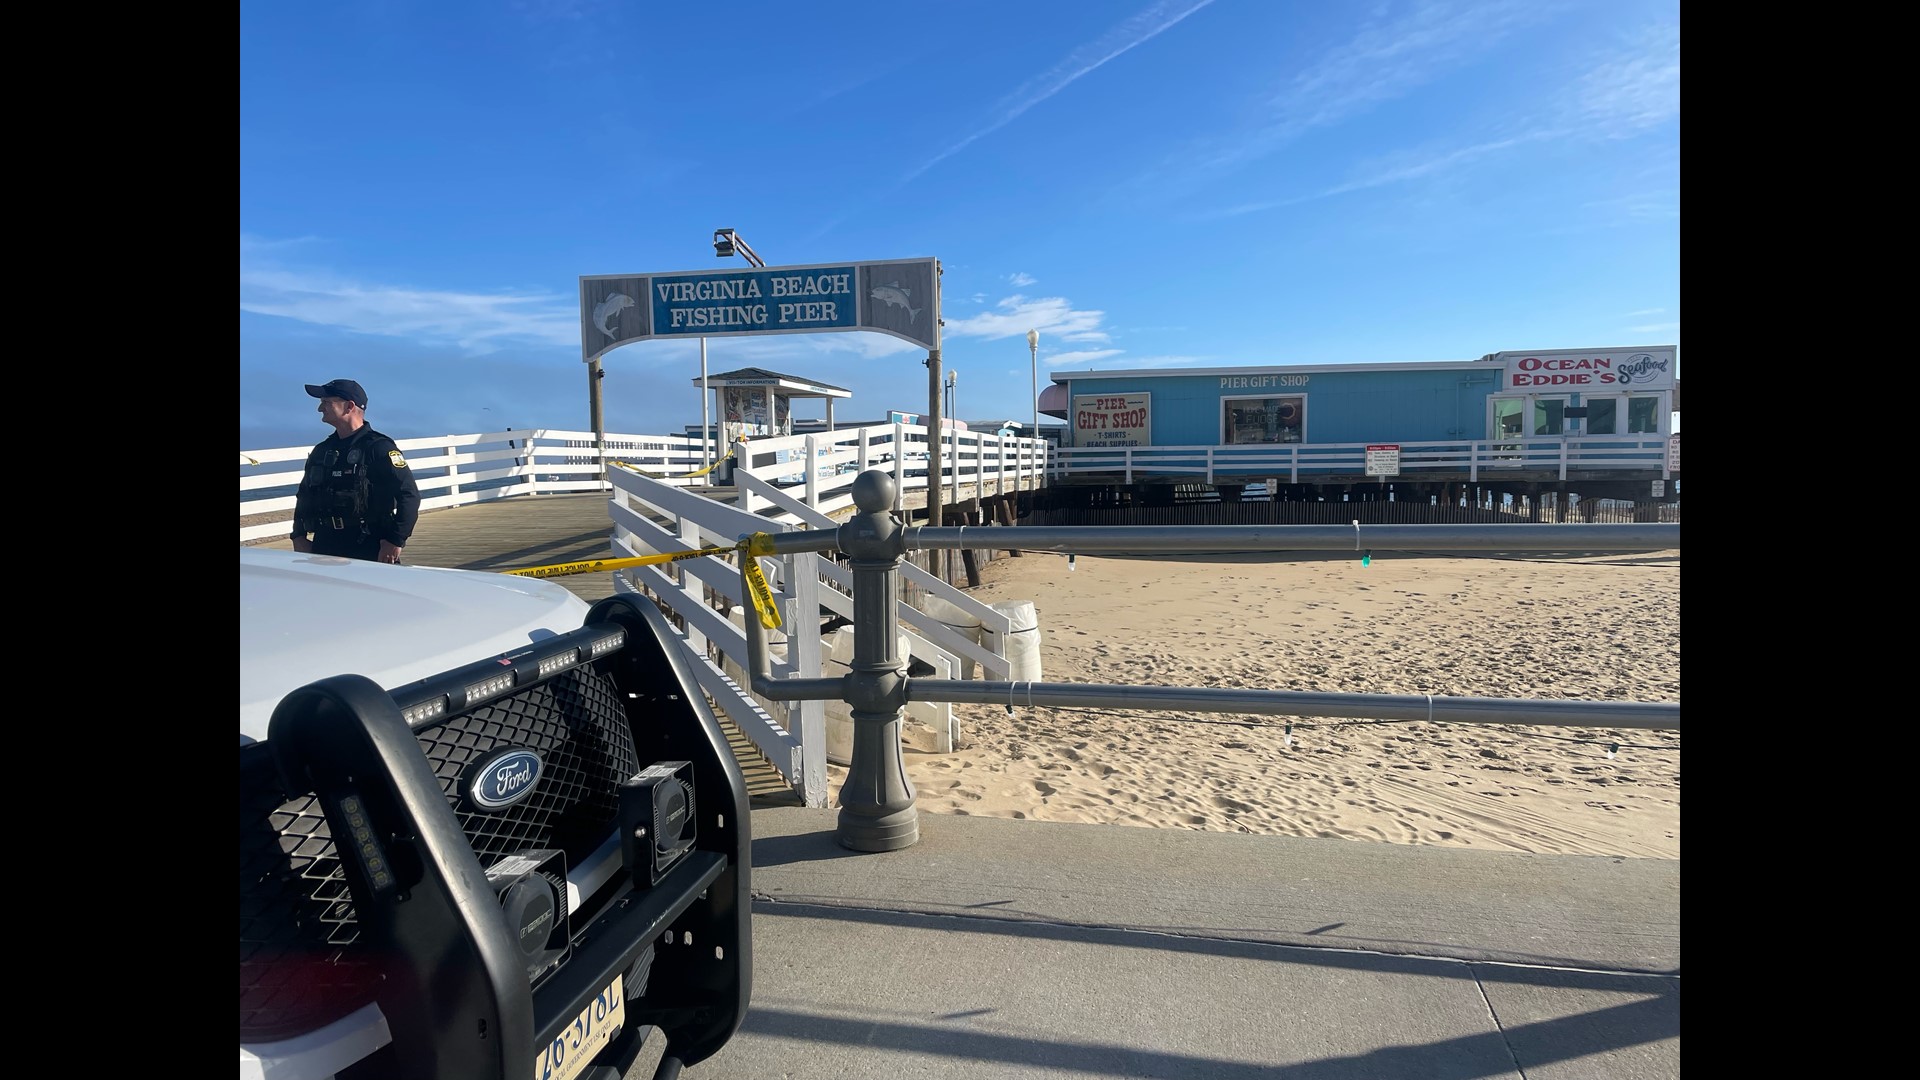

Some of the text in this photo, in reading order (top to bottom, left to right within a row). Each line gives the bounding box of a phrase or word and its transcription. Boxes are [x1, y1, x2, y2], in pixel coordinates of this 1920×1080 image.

[656, 274, 851, 303] VIRGINIA BEACH
[670, 301, 838, 328] FISHING PIER
[1518, 357, 1611, 372] OCEAN
[1617, 356, 1669, 385] Seafood
[1220, 375, 1310, 389] PIER GIFT SHOP
[1512, 370, 1617, 386] EDDIE'S
[1096, 398, 1127, 410] PIER
[1078, 407, 1147, 430] GIFT SHOP
[1097, 431, 1127, 439] T-SHIRTS
[496, 759, 532, 796] Ford
